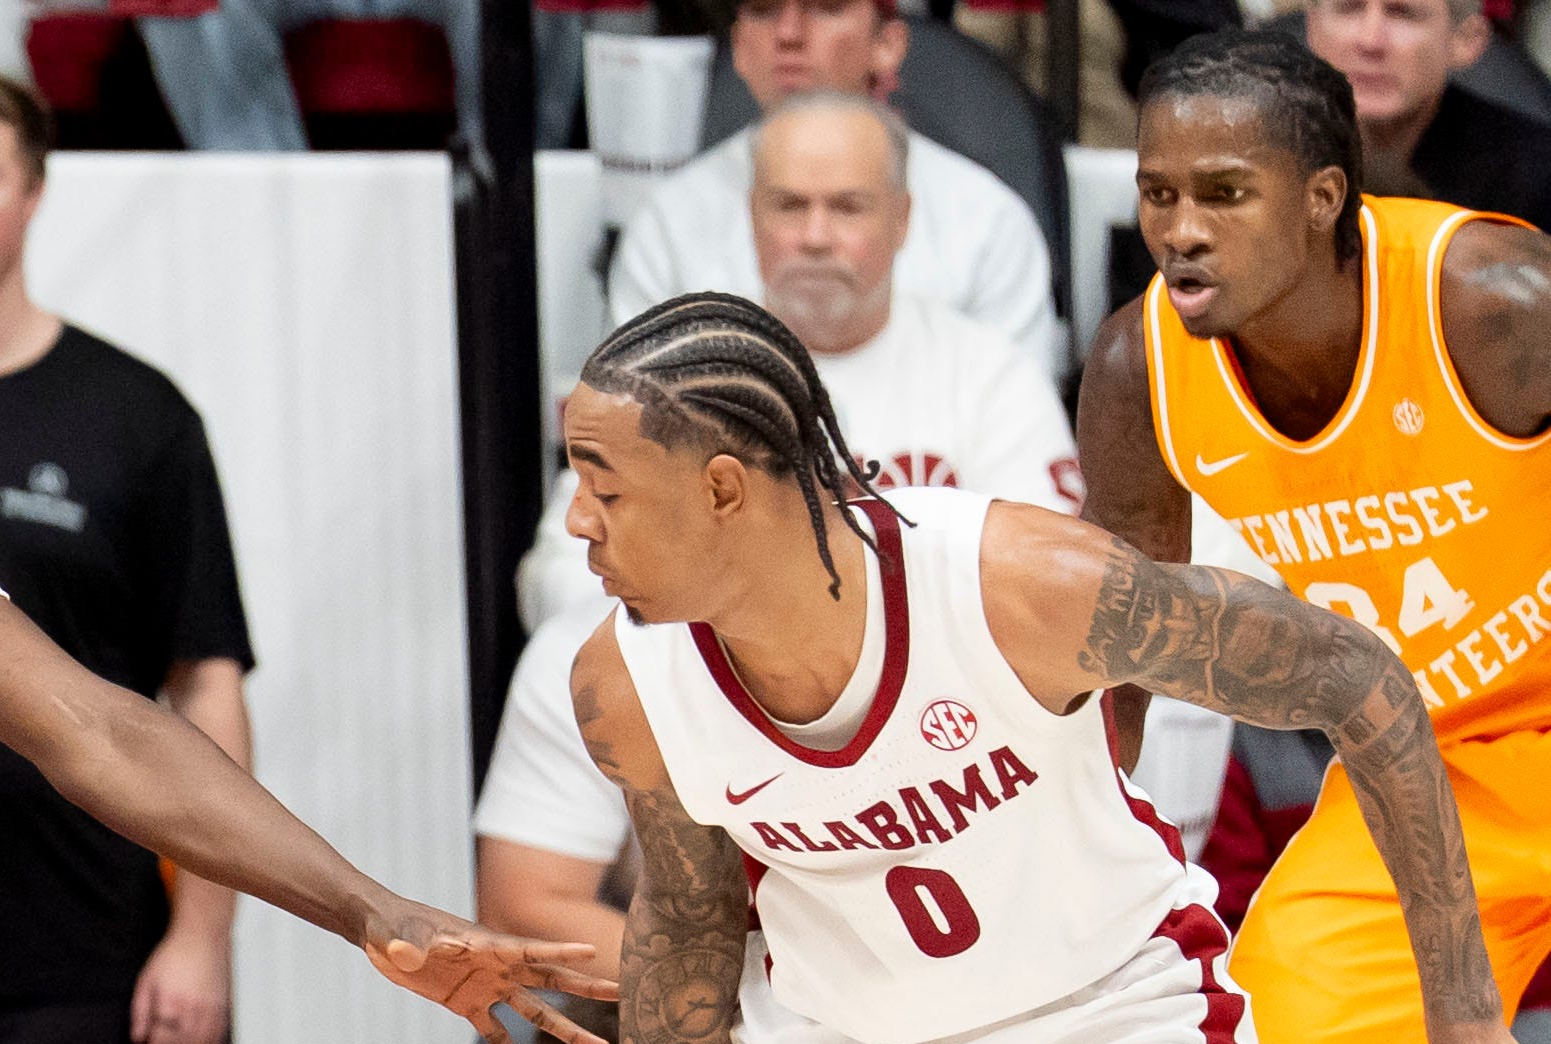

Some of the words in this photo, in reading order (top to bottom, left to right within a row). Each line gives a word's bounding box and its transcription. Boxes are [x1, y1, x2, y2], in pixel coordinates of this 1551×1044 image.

[1228, 479, 1489, 565] ENNESSEE
[921, 700, 977, 751] SEC
[749, 745, 1039, 853] ALABAMA
[885, 865, 980, 958] 0
